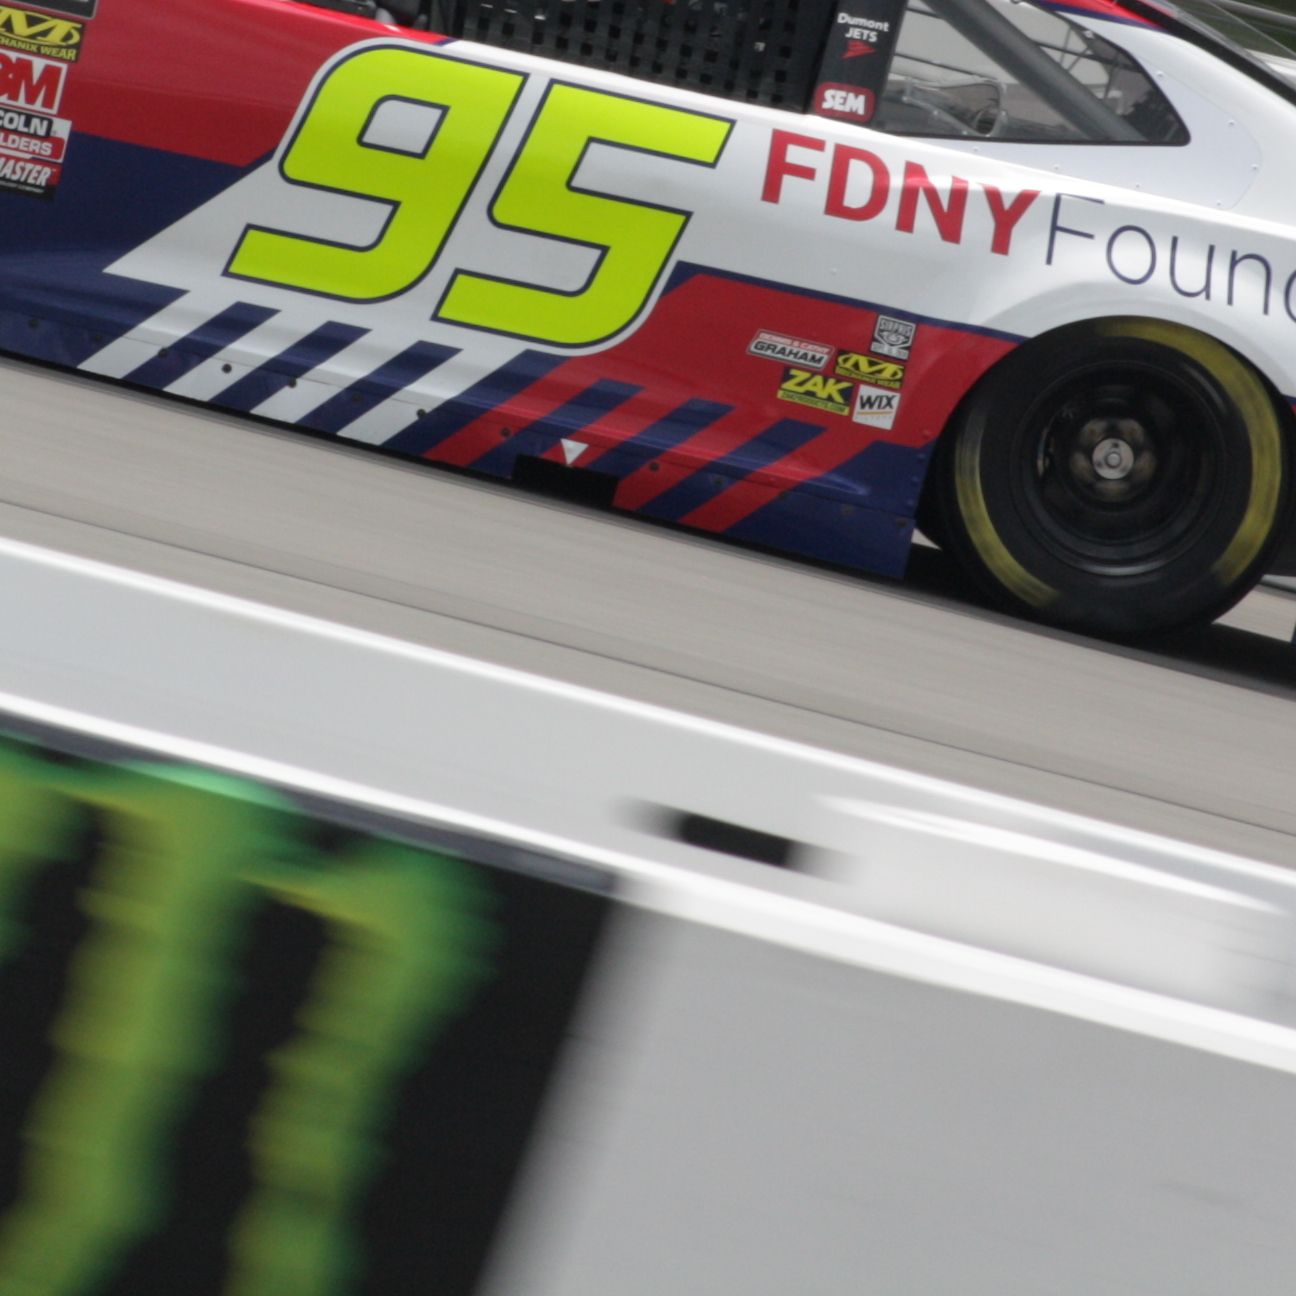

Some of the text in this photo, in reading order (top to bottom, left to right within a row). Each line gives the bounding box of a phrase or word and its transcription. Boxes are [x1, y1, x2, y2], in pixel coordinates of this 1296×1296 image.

[837, 12, 890, 32] Dumont
[845, 27, 878, 42] JETS
[40, 45, 77, 62] WEAR
[822, 89, 866, 115] SEM
[222, 42, 738, 348] 95
[761, 128, 1042, 256] FDNY
[754, 341, 825, 366] GRAHAM
[781, 369, 854, 404] ZAK
[859, 394, 897, 410] WIX
